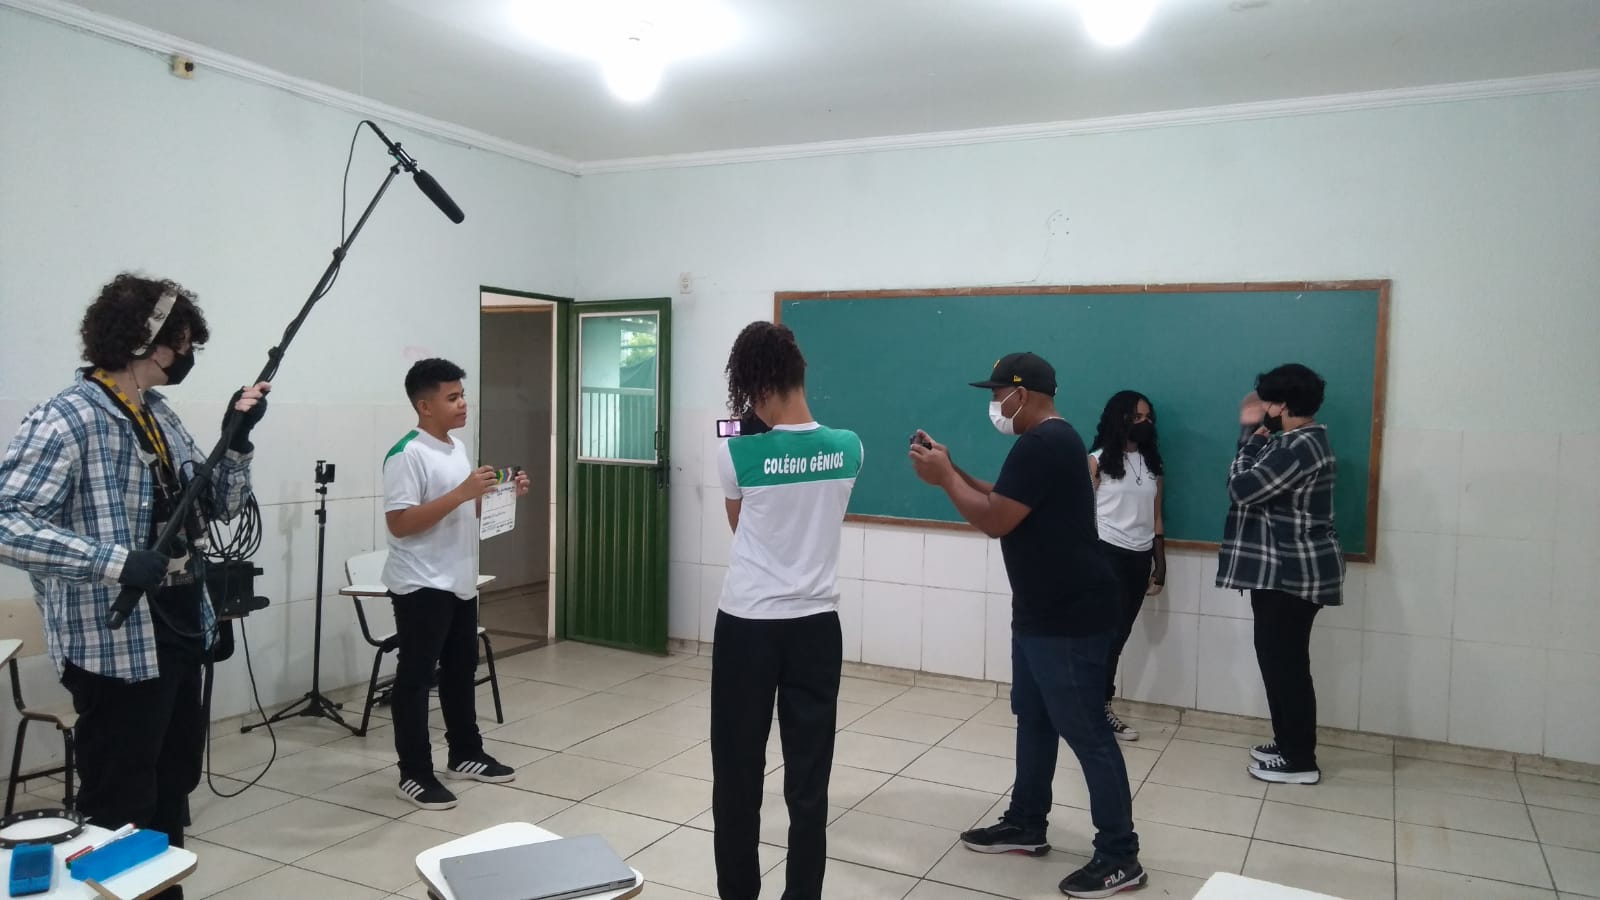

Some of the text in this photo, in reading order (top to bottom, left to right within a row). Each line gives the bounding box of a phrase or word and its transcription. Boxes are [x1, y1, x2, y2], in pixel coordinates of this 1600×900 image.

[763, 451, 844, 475] COLÉGIO GÊNIOS
[1104, 869, 1126, 888] FILA
